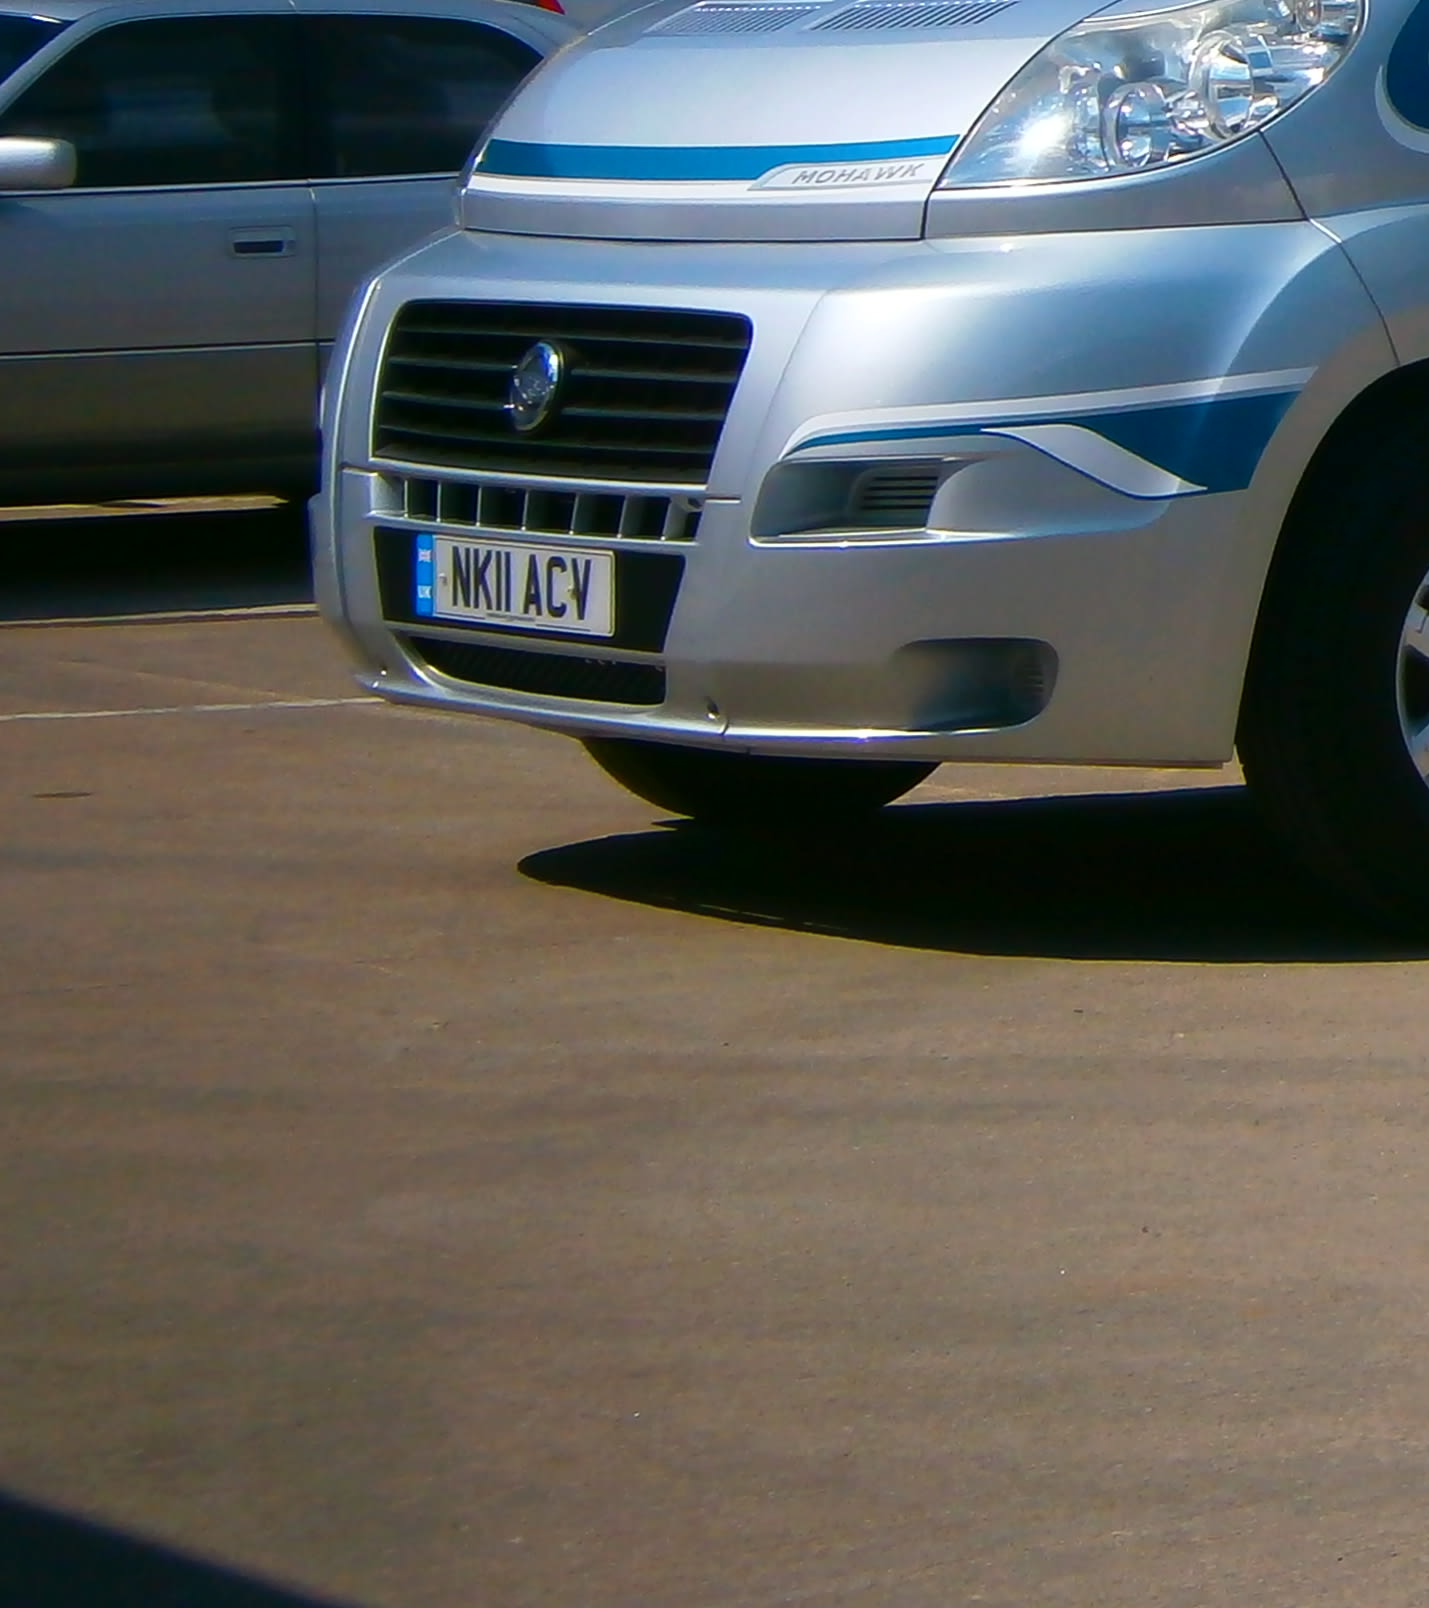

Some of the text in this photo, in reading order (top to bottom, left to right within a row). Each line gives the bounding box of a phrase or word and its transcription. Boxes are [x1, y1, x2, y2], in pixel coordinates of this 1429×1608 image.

[791, 162, 925, 185] MOHAWK
[452, 545, 592, 621] NK11 ACV
